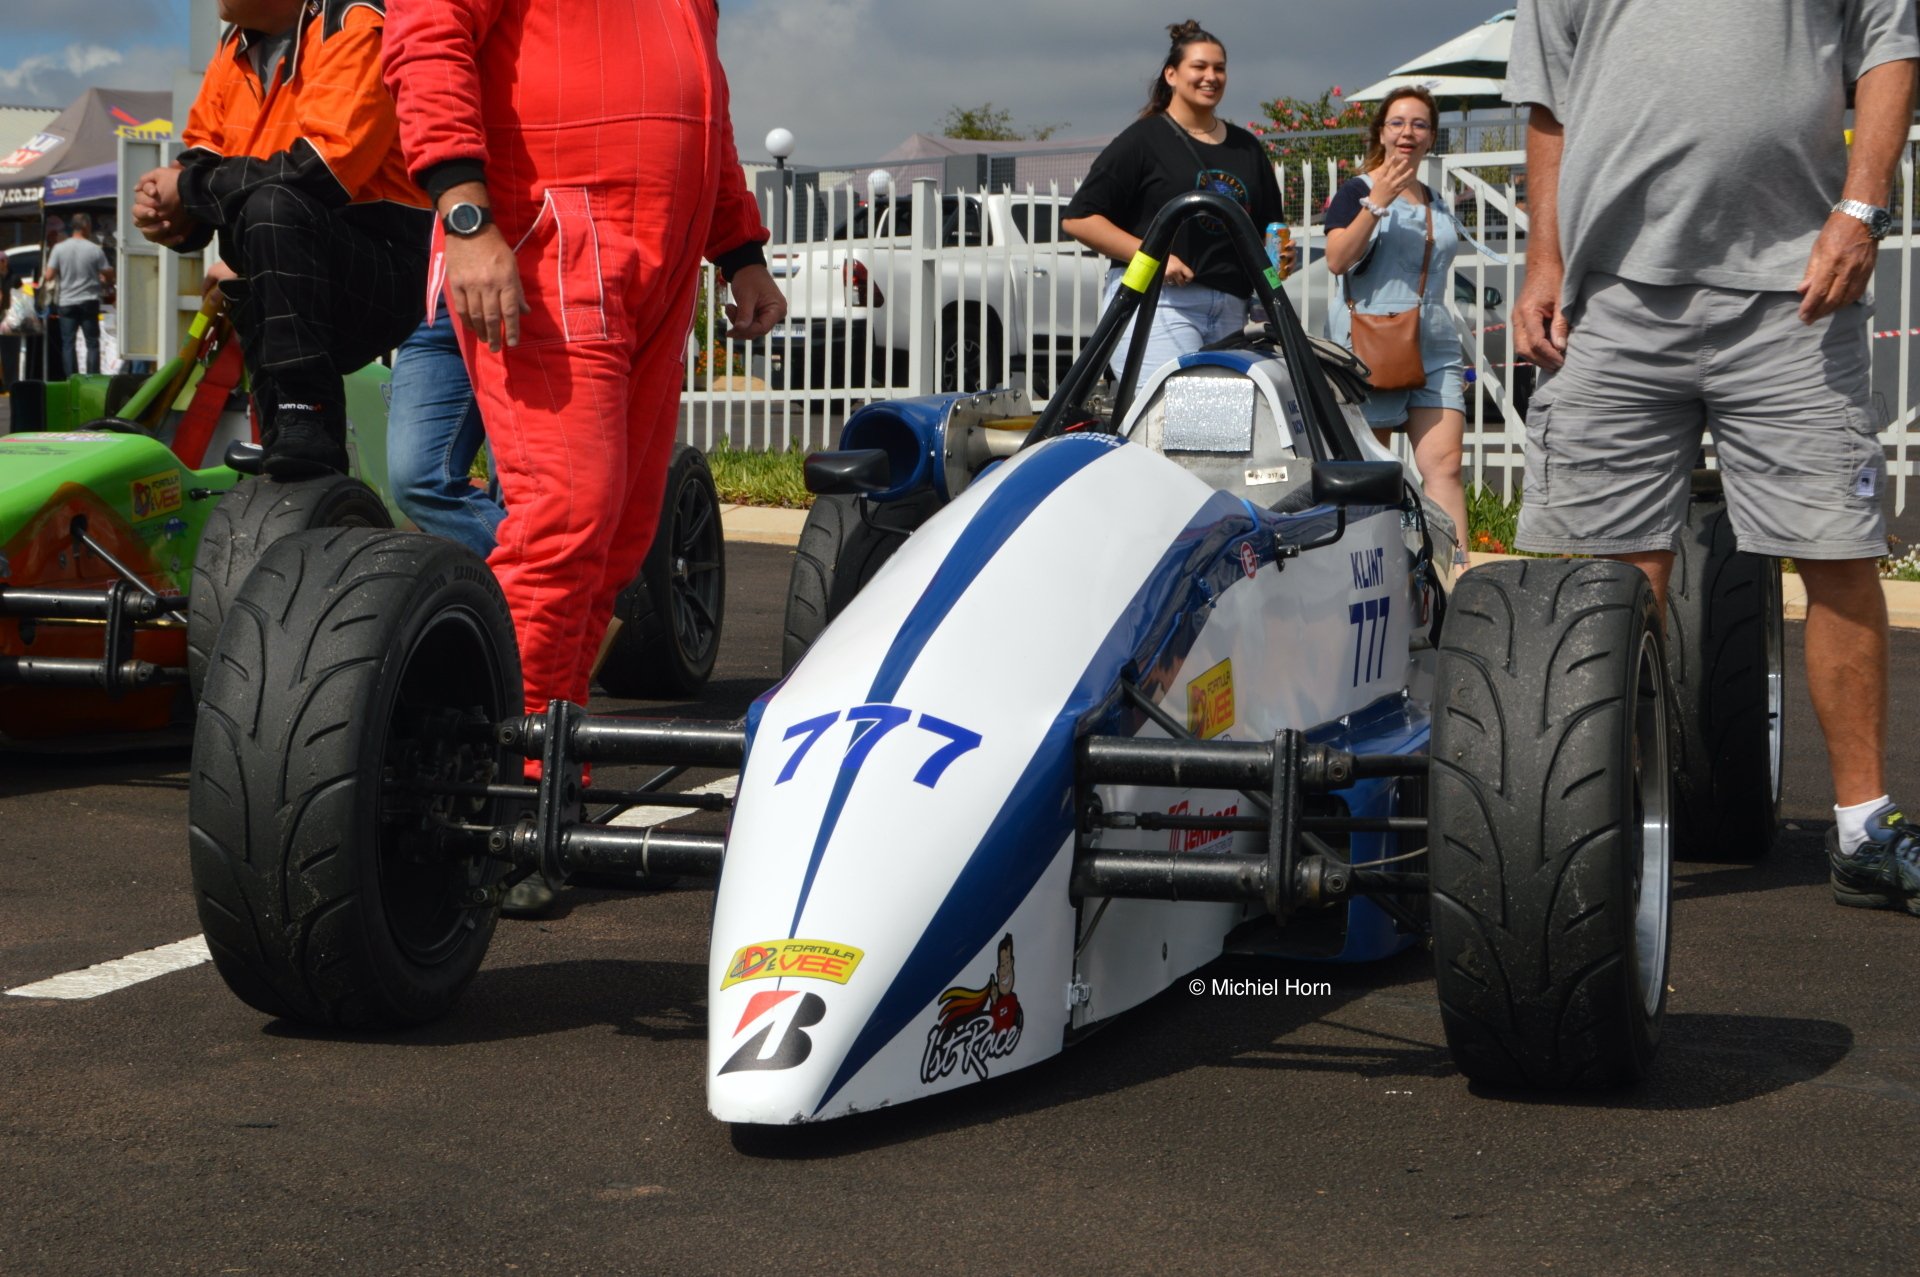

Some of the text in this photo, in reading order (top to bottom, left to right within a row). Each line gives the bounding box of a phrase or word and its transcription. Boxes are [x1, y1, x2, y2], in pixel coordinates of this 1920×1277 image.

[1350, 547, 1384, 590] KLINT
[1348, 596, 1391, 688] 777
[774, 704, 983, 789] 777
[779, 954, 850, 977] VEE
[783, 945, 855, 960] FORMULA
